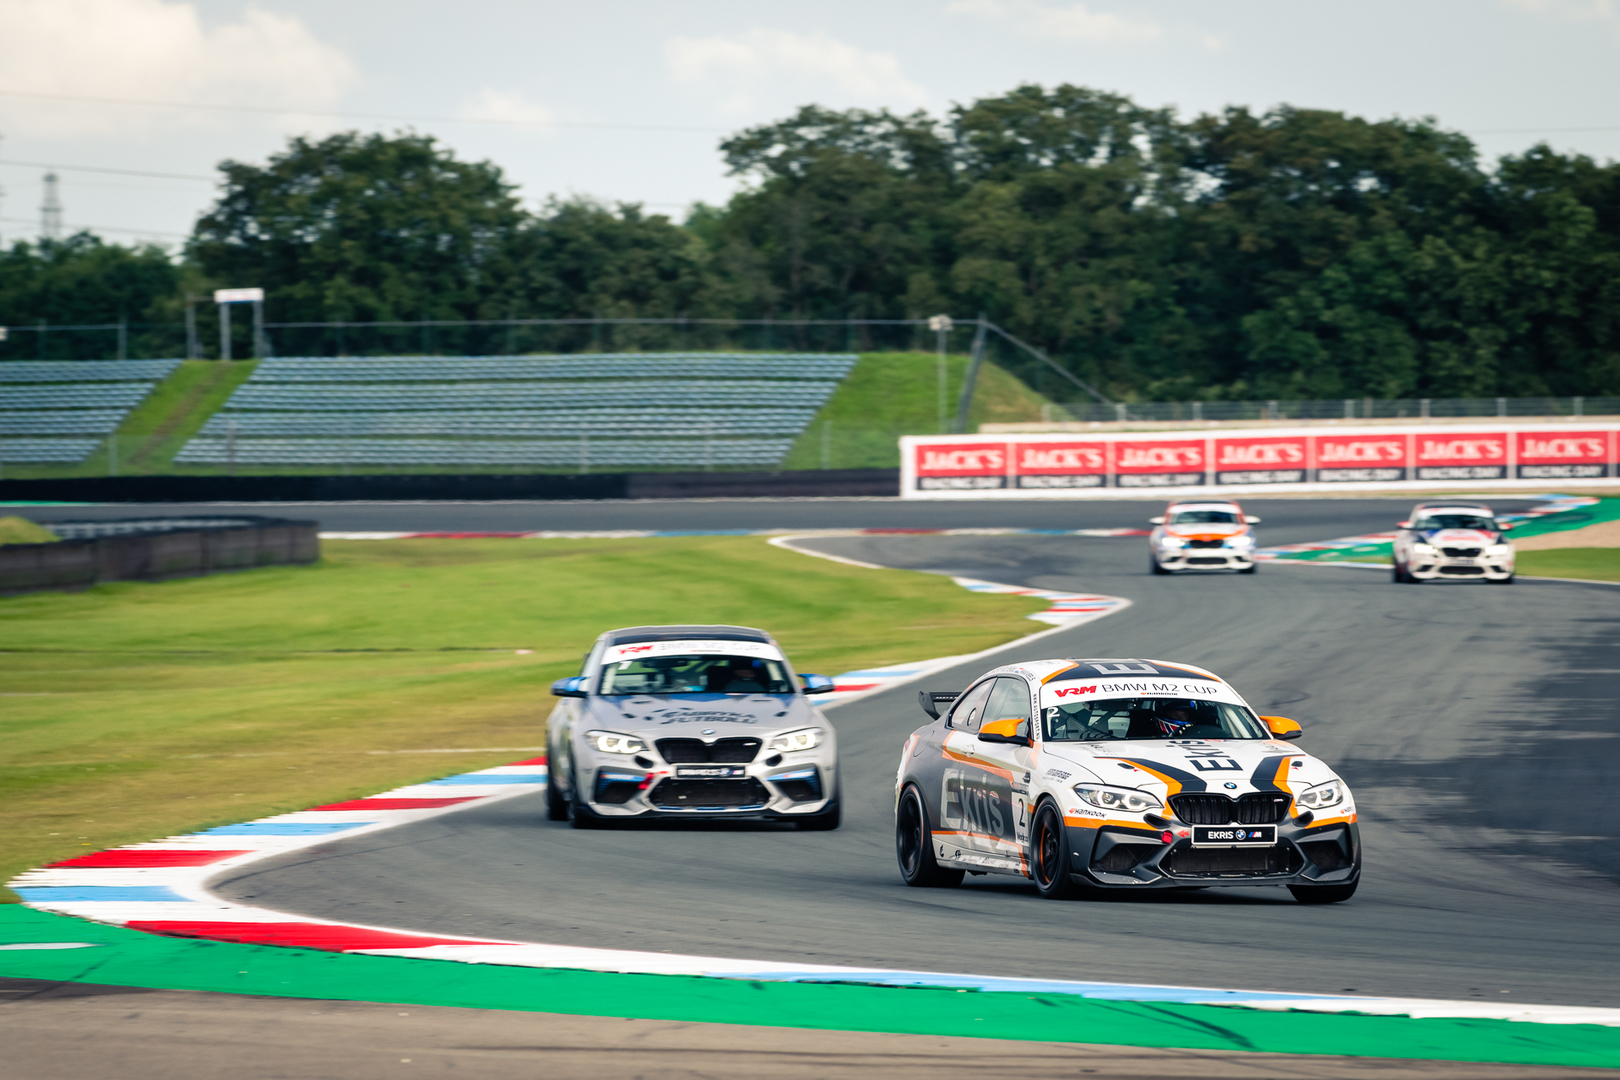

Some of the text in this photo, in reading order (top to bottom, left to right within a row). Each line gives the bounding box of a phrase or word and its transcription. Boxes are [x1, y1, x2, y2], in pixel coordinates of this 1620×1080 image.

[1118, 447, 1202, 467] JACK'S
[1219, 443, 1303, 464] JACK'S
[1319, 441, 1403, 461] JACK'S
[1419, 440, 1503, 460] JACK'S
[1520, 438, 1604, 458] JACK'S
[920, 450, 1003, 470] JACK'S
[1020, 449, 1103, 469] JACK'S
[1054, 683, 1218, 698] VRM BMW M2 CUP
[1048, 707, 1060, 718] 2
[1018, 797, 1026, 828] 2
[1208, 831, 1234, 839] EKRIS
